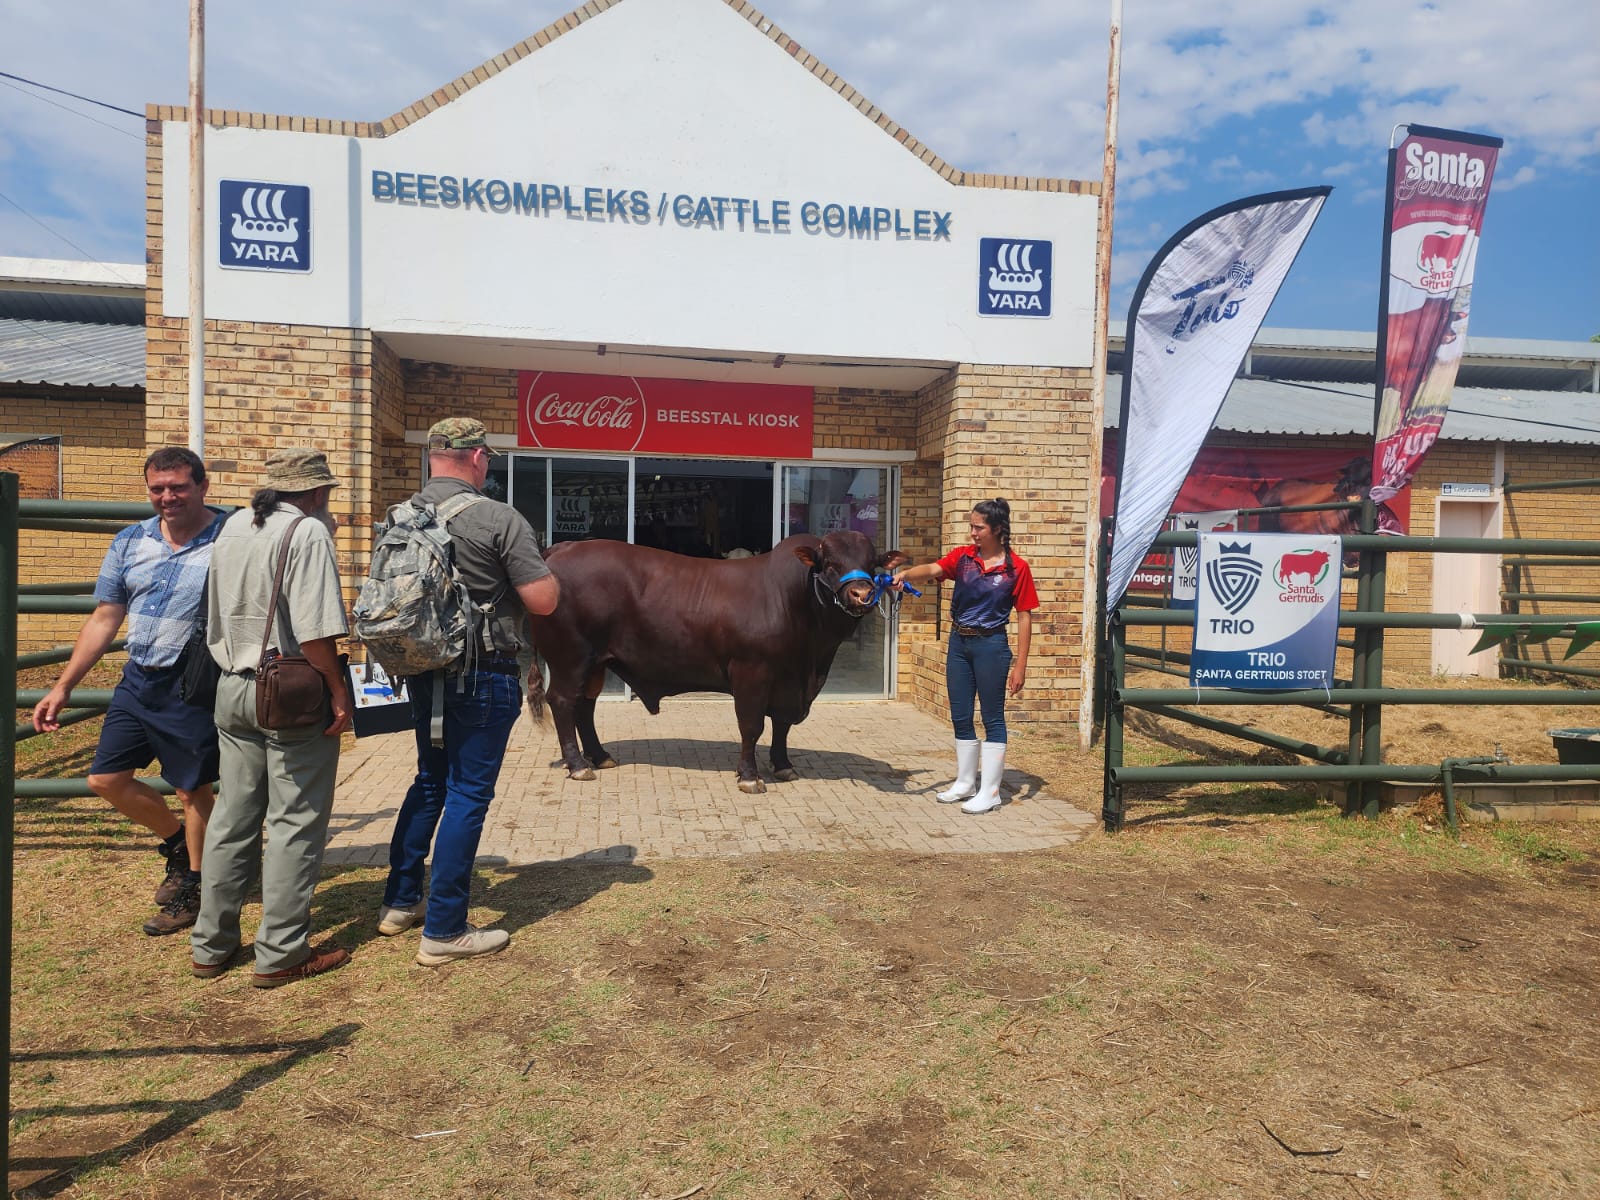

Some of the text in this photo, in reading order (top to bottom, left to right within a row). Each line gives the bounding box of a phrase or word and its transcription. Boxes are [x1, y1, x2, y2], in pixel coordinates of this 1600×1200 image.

[1405, 142, 1486, 188] Santa
[372, 169, 651, 217] BEESKOMPLEKS
[672, 194, 790, 225] CATTLE
[800, 201, 953, 236] COMPLEX
[230, 242, 300, 263] YARA
[1429, 268, 1454, 280] Snta
[987, 292, 1043, 310] YARA
[534, 392, 639, 430] Coca-Cola
[656, 409, 801, 428] BEESSTAL KIOSK
[555, 522, 586, 532] YARA
[1178, 575, 1198, 588] TRIO
[1286, 584, 1316, 594] Santa
[1278, 592, 1326, 604] Gertrudis
[1209, 618, 1255, 635] TRIO
[1247, 651, 1287, 667] TRIO
[1195, 669, 1328, 681] SANTA GERTRUDIS STOET
